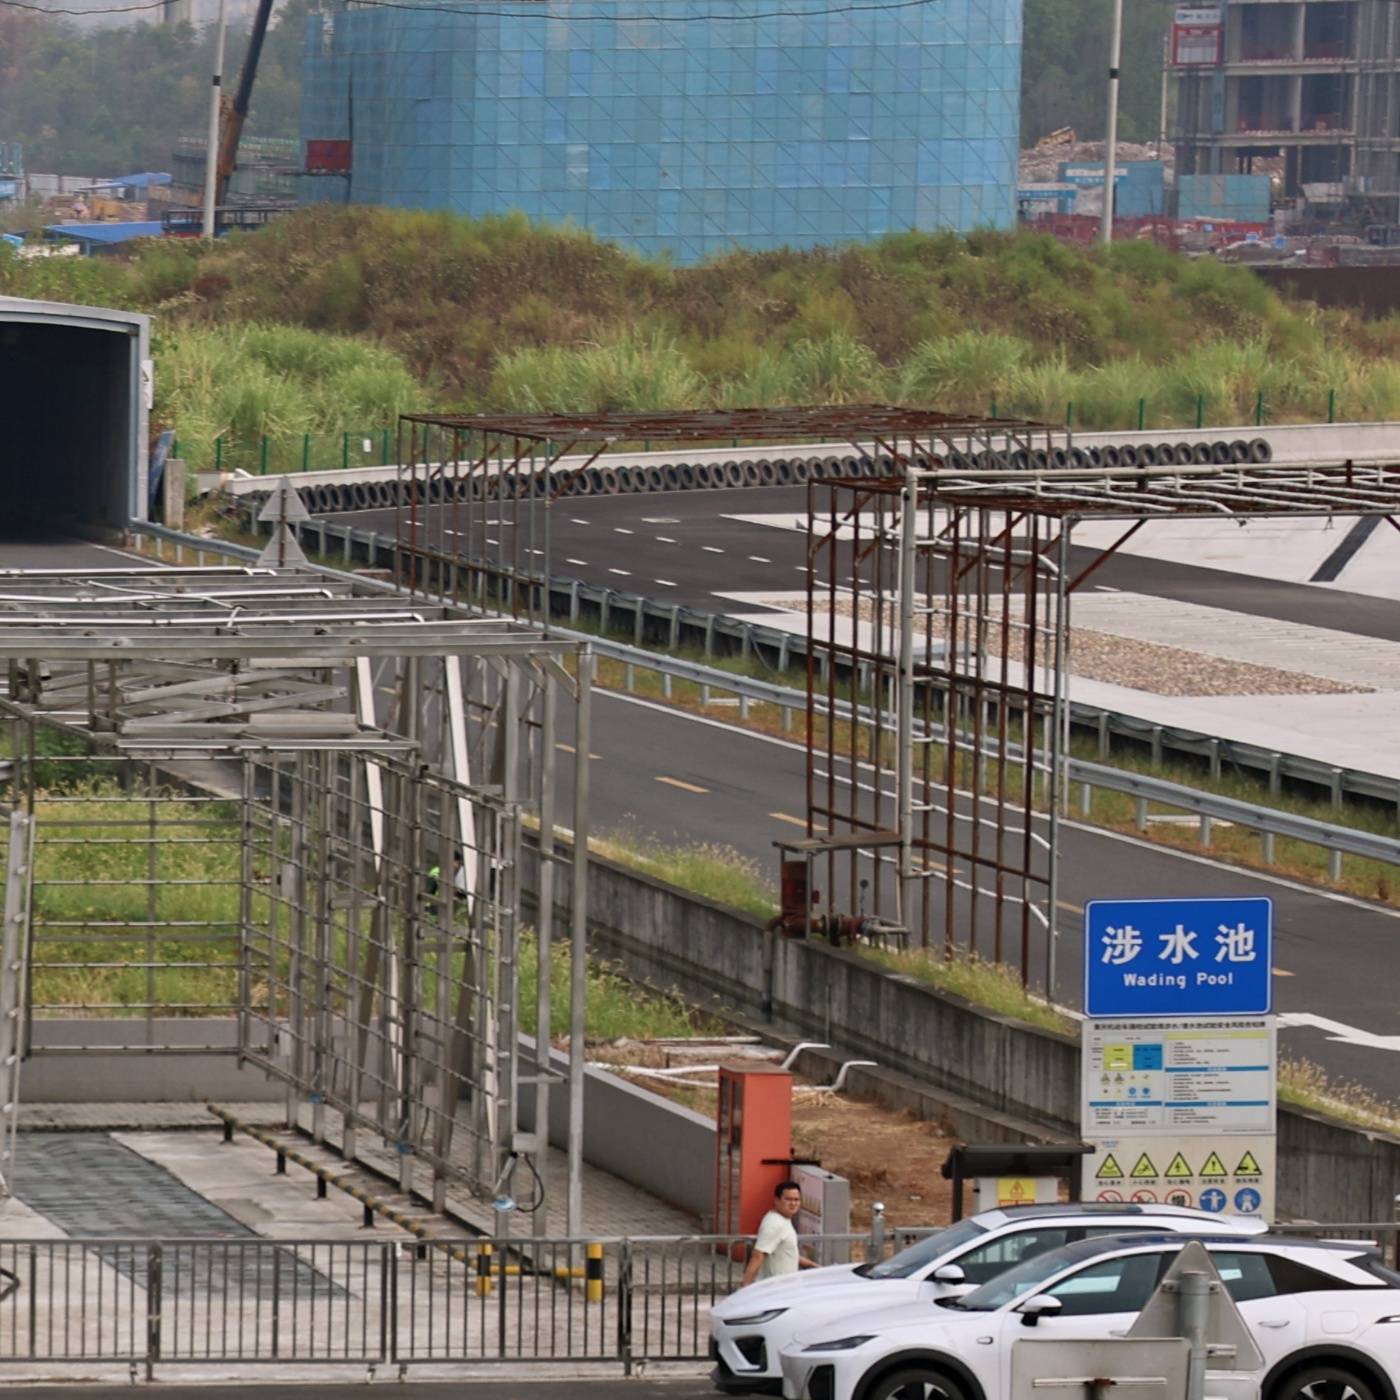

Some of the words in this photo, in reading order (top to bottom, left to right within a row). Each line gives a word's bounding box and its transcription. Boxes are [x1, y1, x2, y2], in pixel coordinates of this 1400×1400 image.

[1101, 923, 1256, 965] 涉水池
[1123, 973, 1186, 988] Wading
[1196, 972, 1234, 985] Pool
